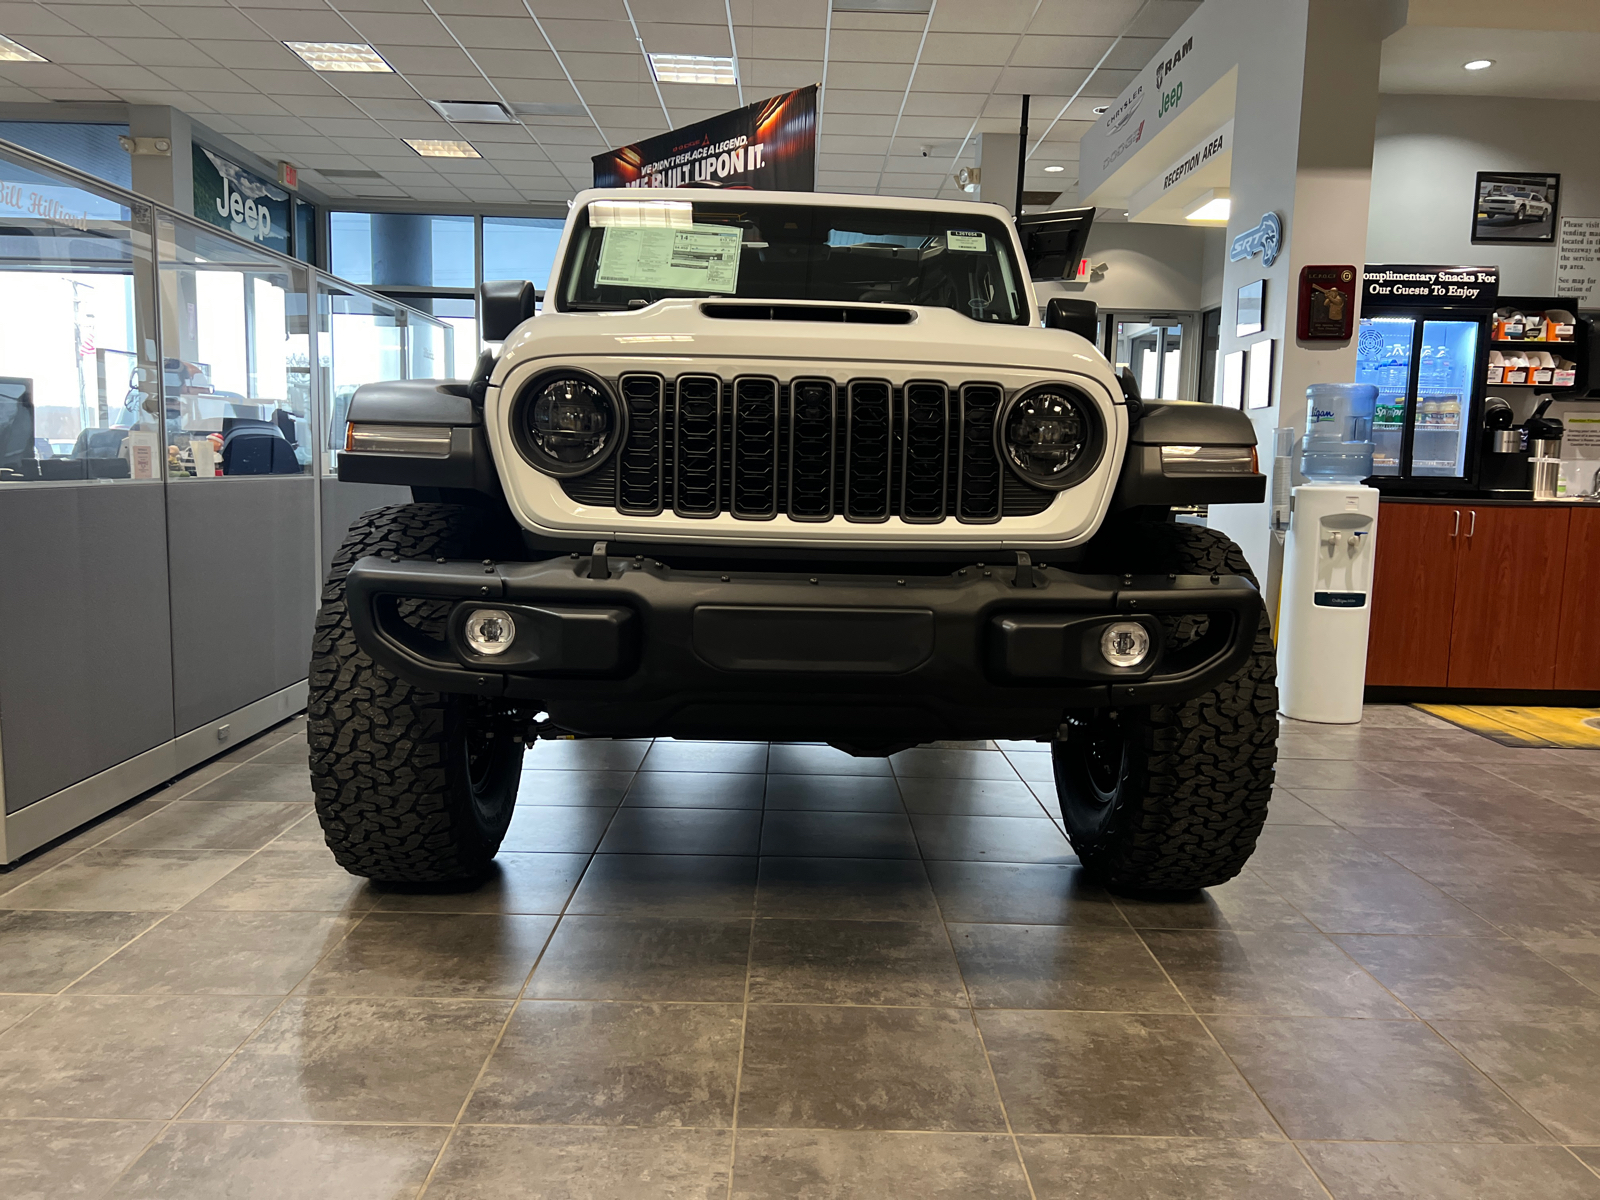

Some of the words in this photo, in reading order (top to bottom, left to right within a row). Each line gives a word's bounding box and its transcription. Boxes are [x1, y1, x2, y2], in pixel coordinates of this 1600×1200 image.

[1164, 36, 1193, 77] RAM
[1106, 85, 1143, 127] CHRYSLER
[1158, 81, 1183, 118] Jeep
[694, 148, 744, 181] UPON
[747, 143, 766, 171] IT.
[707, 146, 715, 156] A
[1102, 129, 1140, 170] DODGE
[1163, 151, 1201, 190] RECEPTION
[1201, 134, 1223, 162] AREA
[28, 192, 88, 232] Hilliard
[216, 176, 271, 240] Jeep
[1232, 231, 1264, 254] SRT
[1562, 237, 1584, 245] located
[1363, 270, 1437, 284] omplimentary
[1438, 272, 1476, 283] Snacks
[1477, 273, 1497, 283] For
[1369, 284, 1391, 295] Our
[1393, 284, 1429, 295] Guests
[1431, 285, 1446, 296] To
[1447, 285, 1480, 299] Enjoy
